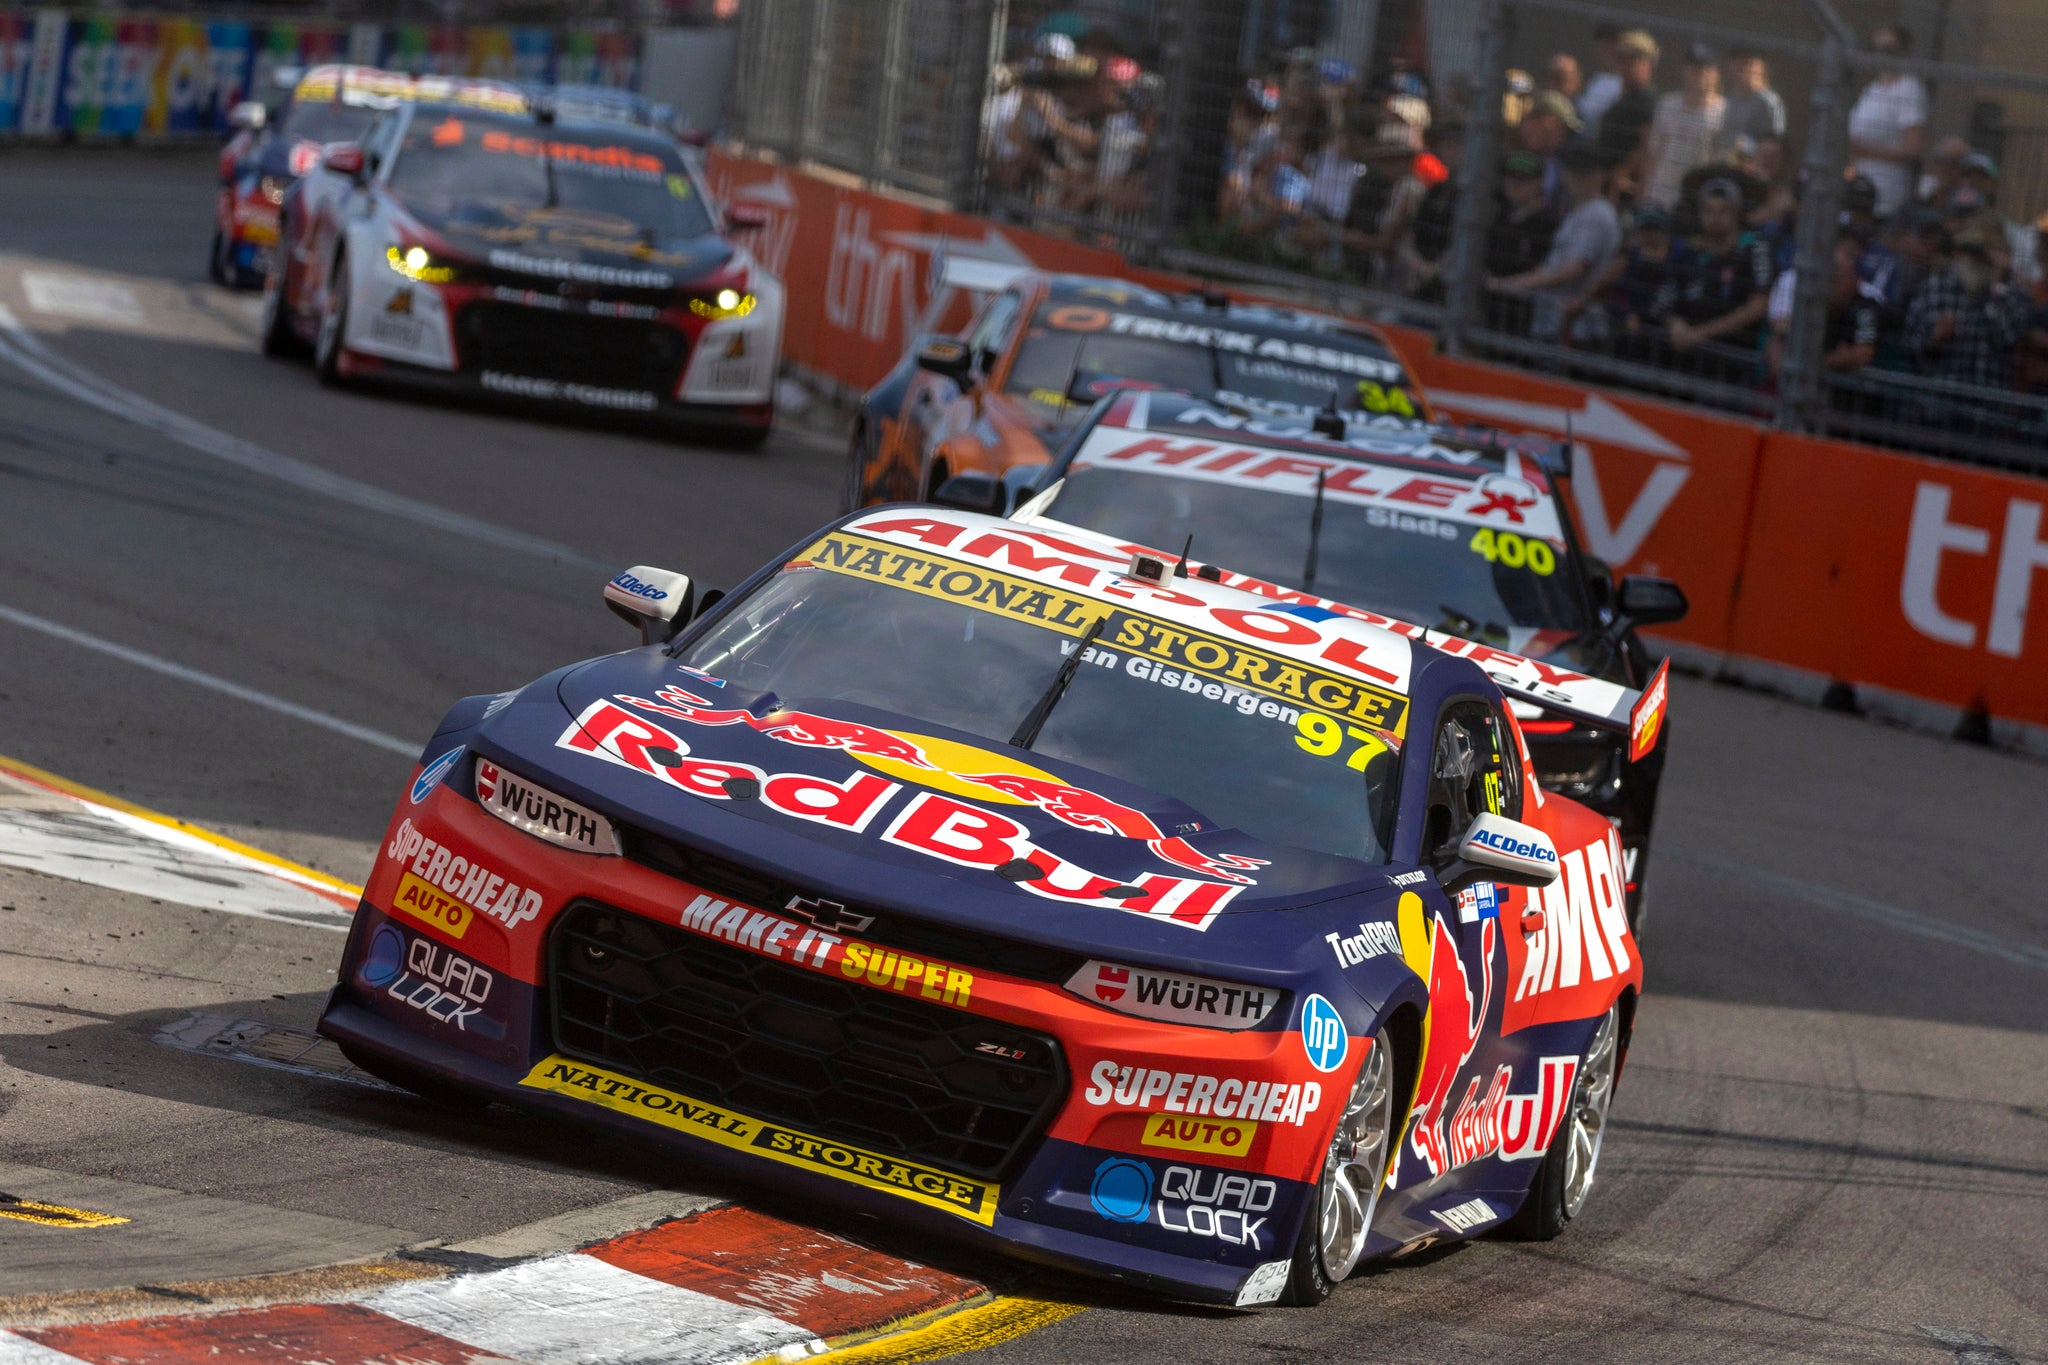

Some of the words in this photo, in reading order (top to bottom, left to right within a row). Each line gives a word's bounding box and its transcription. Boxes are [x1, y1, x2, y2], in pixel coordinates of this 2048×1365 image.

[1356, 380, 1414, 416] 34
[1107, 437, 1537, 523] HIFLEX
[1366, 507, 1458, 541] Slade
[1469, 527, 1555, 576] 400
[811, 538, 1088, 629] NATIONAL
[1116, 618, 1392, 726] STORAGE
[1059, 639, 1118, 669] van
[1125, 656, 1299, 726] Gisbergen
[1294, 712, 1389, 773] 97
[500, 779, 597, 846] WÜRTH
[388, 817, 543, 929] SUPERCHEAP
[1472, 828, 1556, 863] ACDelco
[402, 884, 463, 926] AUTO
[408, 938, 493, 1004] QUAD
[680, 894, 798, 956] MAKE
[793, 930, 842, 969] IT
[840, 942, 974, 1008] SUPER
[388, 971, 483, 1031] LOCK
[1136, 975, 1265, 1020] WÜRTH
[1308, 996, 1338, 1069] hp
[1084, 1060, 1322, 1127] SUPERCHEAP
[544, 1063, 749, 1138] NATIONAL
[770, 1132, 975, 1205] STORAGE
[1154, 1119, 1242, 1147] AUTO
[1160, 1165, 1276, 1212] QUAD
[1157, 1199, 1268, 1251] LOCK
